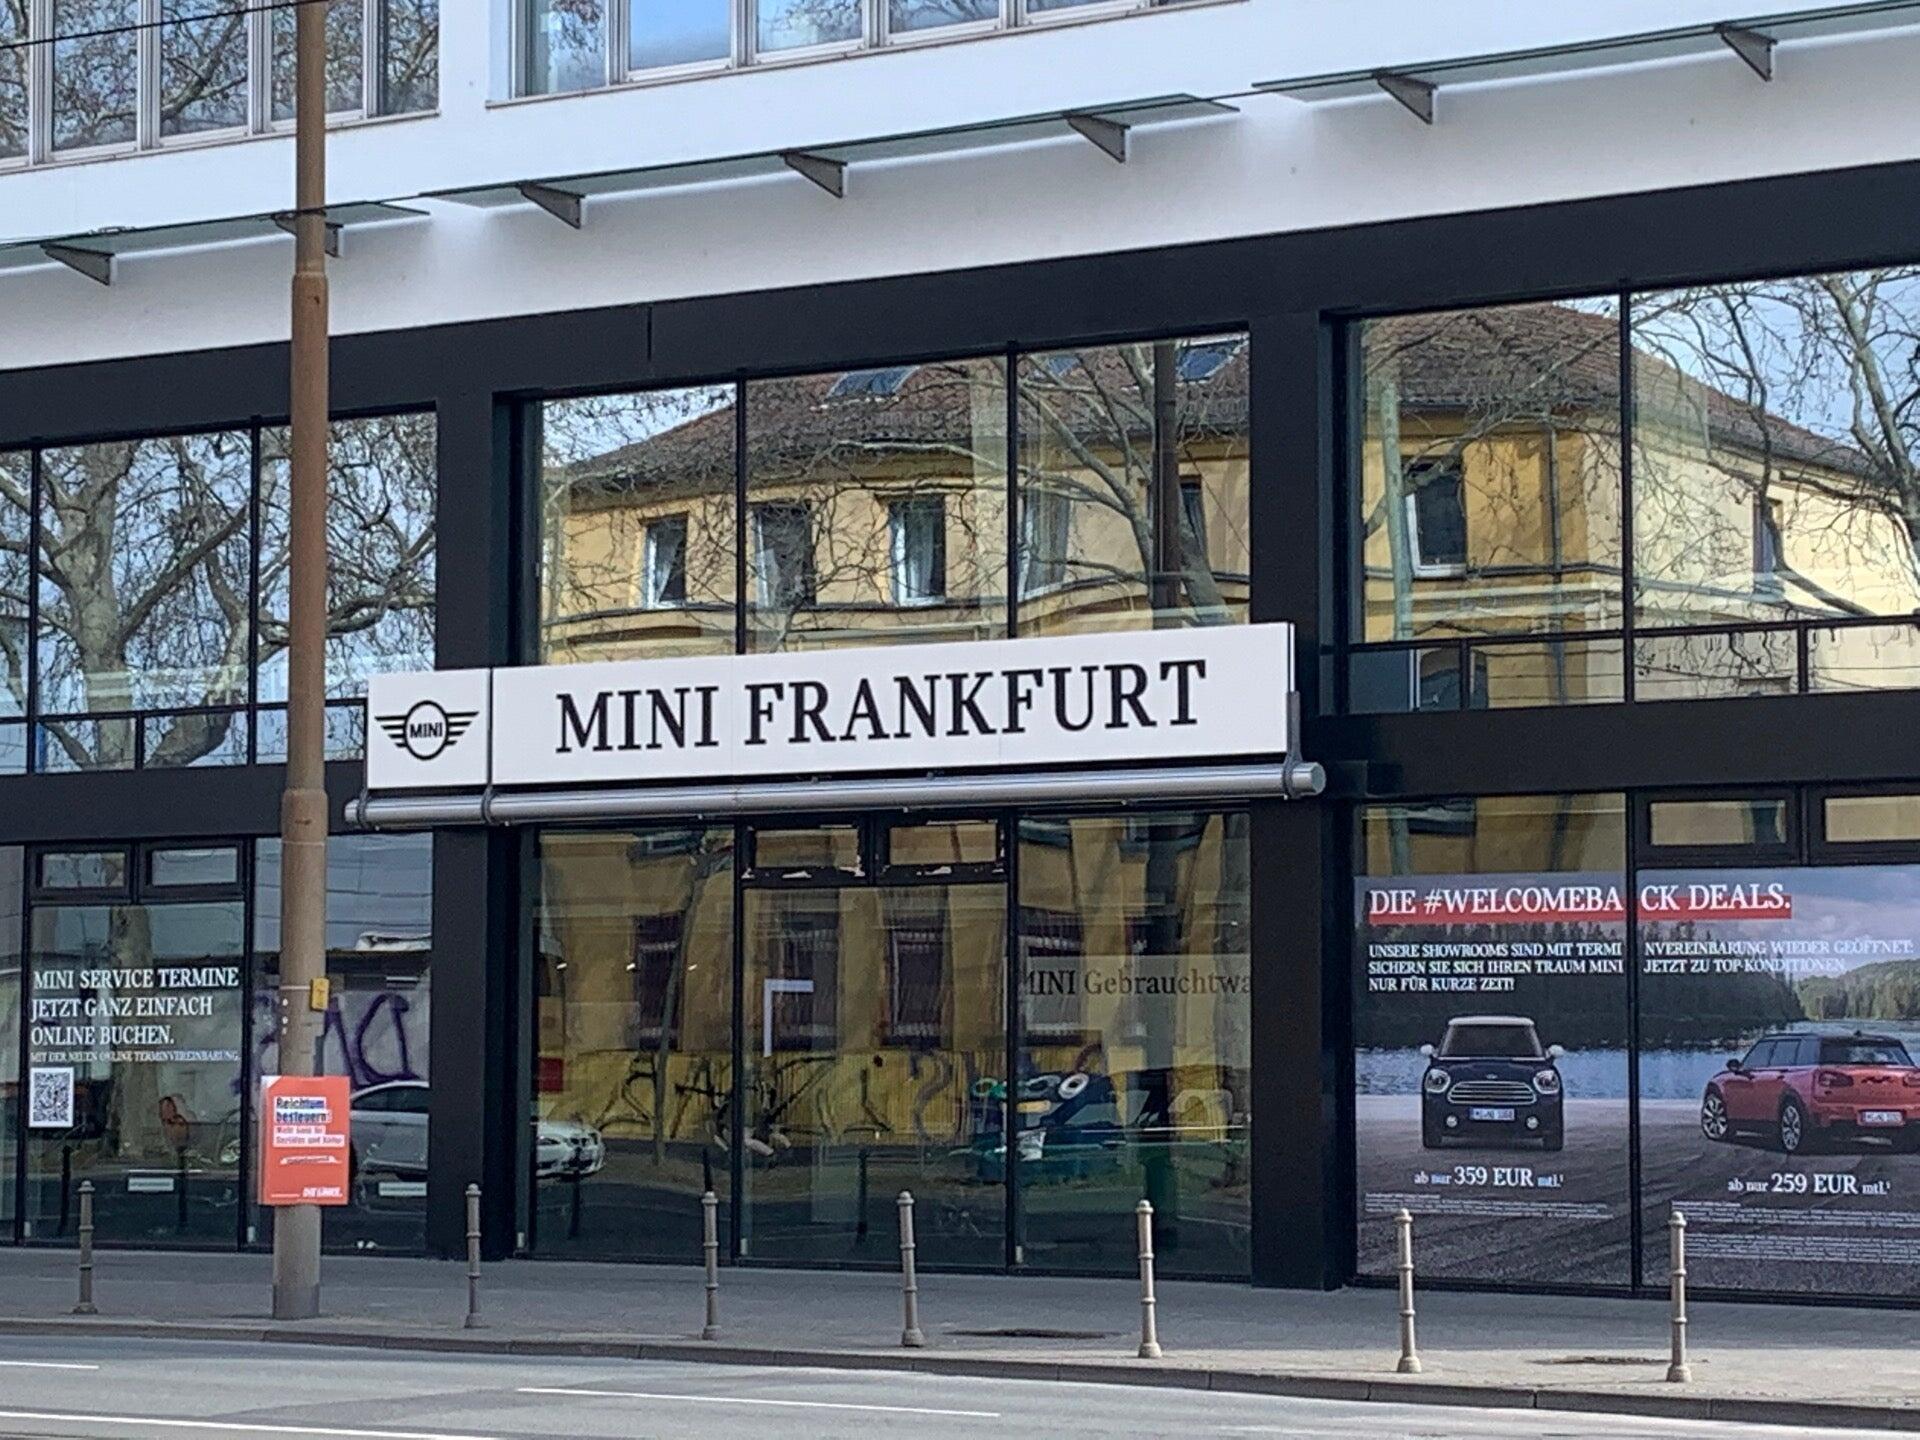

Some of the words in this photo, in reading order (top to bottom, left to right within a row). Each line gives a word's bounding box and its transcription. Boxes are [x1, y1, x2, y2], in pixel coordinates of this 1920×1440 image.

[555, 686, 719, 753] MINI
[744, 659, 1206, 746] FRANKFURT
[409, 722, 443, 738] MINI
[1369, 889, 1417, 915] DIE
[1688, 883, 1792, 910] DEALS.
[1369, 944, 1420, 958] UNSERE
[1422, 943, 1508, 957] SHOWROOMS
[1511, 943, 1543, 956] SIND
[1546, 943, 1573, 956] MIT
[1771, 940, 1830, 955] WIEDER
[1368, 961, 1426, 975] SICHERN
[1428, 961, 1451, 974] SIE
[1453, 960, 1484, 974] SICH
[1488, 960, 1532, 974] IHREN
[1535, 960, 1586, 973] TRAUM
[1589, 959, 1624, 973] MINI
[1643, 958, 1688, 973] JETZT
[1690, 958, 1710, 973] ZU
[34, 970, 74, 989] MINI
[80, 969, 154, 989] SERVICE
[157, 967, 239, 987] TERMINE
[1369, 979, 1397, 991] NUR
[1400, 976, 1428, 991] FÜR
[1431, 978, 1477, 990] KURZE
[31, 998, 81, 1022] JETZT
[85, 997, 132, 1017] GANZ
[136, 996, 213, 1016] EINFACH
[31, 1027, 95, 1046] ONLINE
[100, 1025, 175, 1045] BUCHEN.
[1414, 1172, 1429, 1184] ab
[1454, 1166, 1487, 1185] 359
[1492, 1167, 1534, 1187] EUR
[1728, 1178, 1743, 1191] ab
[1746, 1181, 1768, 1192] nur
[1771, 1173, 1807, 1193] 259
[1813, 1174, 1857, 1194] EUR
